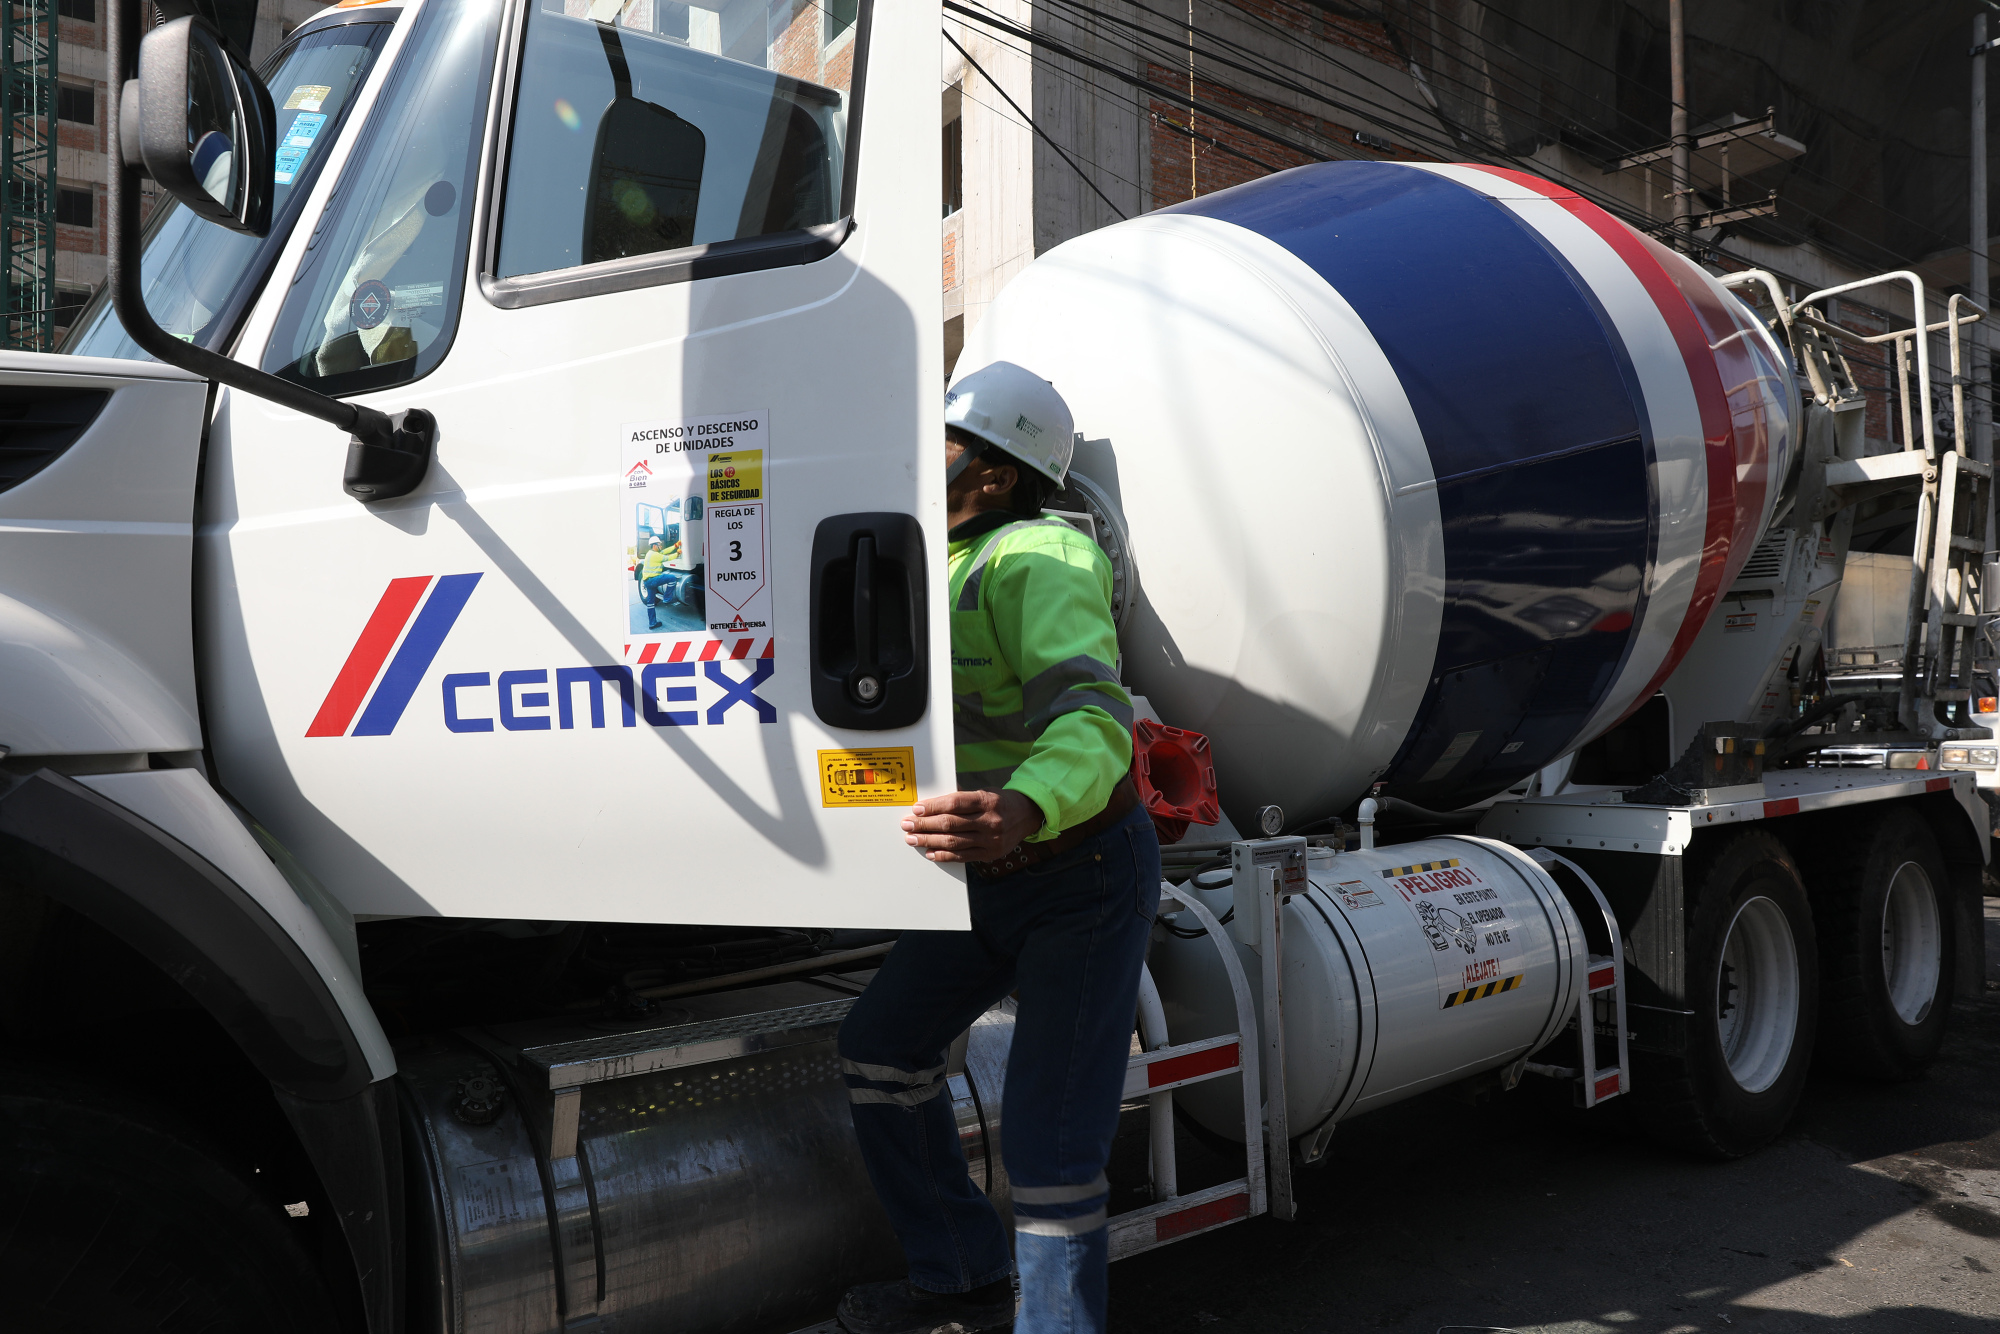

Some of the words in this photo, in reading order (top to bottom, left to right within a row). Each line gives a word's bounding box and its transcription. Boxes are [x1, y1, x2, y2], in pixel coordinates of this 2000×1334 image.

[631, 427, 684, 442] ASCENSO
[687, 426, 695, 437] Y
[697, 419, 759, 436] DESCENSO
[656, 442, 671, 454] DE
[674, 437, 734, 452] UNIDADES
[710, 469, 723, 478] LOS
[726, 468, 734, 476] 12
[710, 479, 740, 490] BÁSICOS
[710, 491, 719, 501] DE
[721, 489, 759, 500] SEGURIDAD
[715, 508, 741, 518] REGLA
[744, 507, 755, 516] DE
[727, 521, 743, 530] LOS
[729, 540, 742, 562] 3
[717, 571, 756, 582] PUNTOS
[952, 657, 992, 667] CEMEX
[442, 659, 777, 733] CEMEX
[1453, 894, 1466, 905] EN
[1462, 891, 1480, 903] ESTE
[1475, 888, 1497, 901] PUNTO
[1467, 912, 1478, 924] EL
[1475, 907, 1506, 923] OPERADOR
[1484, 933, 1495, 946] NO
[1493, 931, 1503, 944] TE
